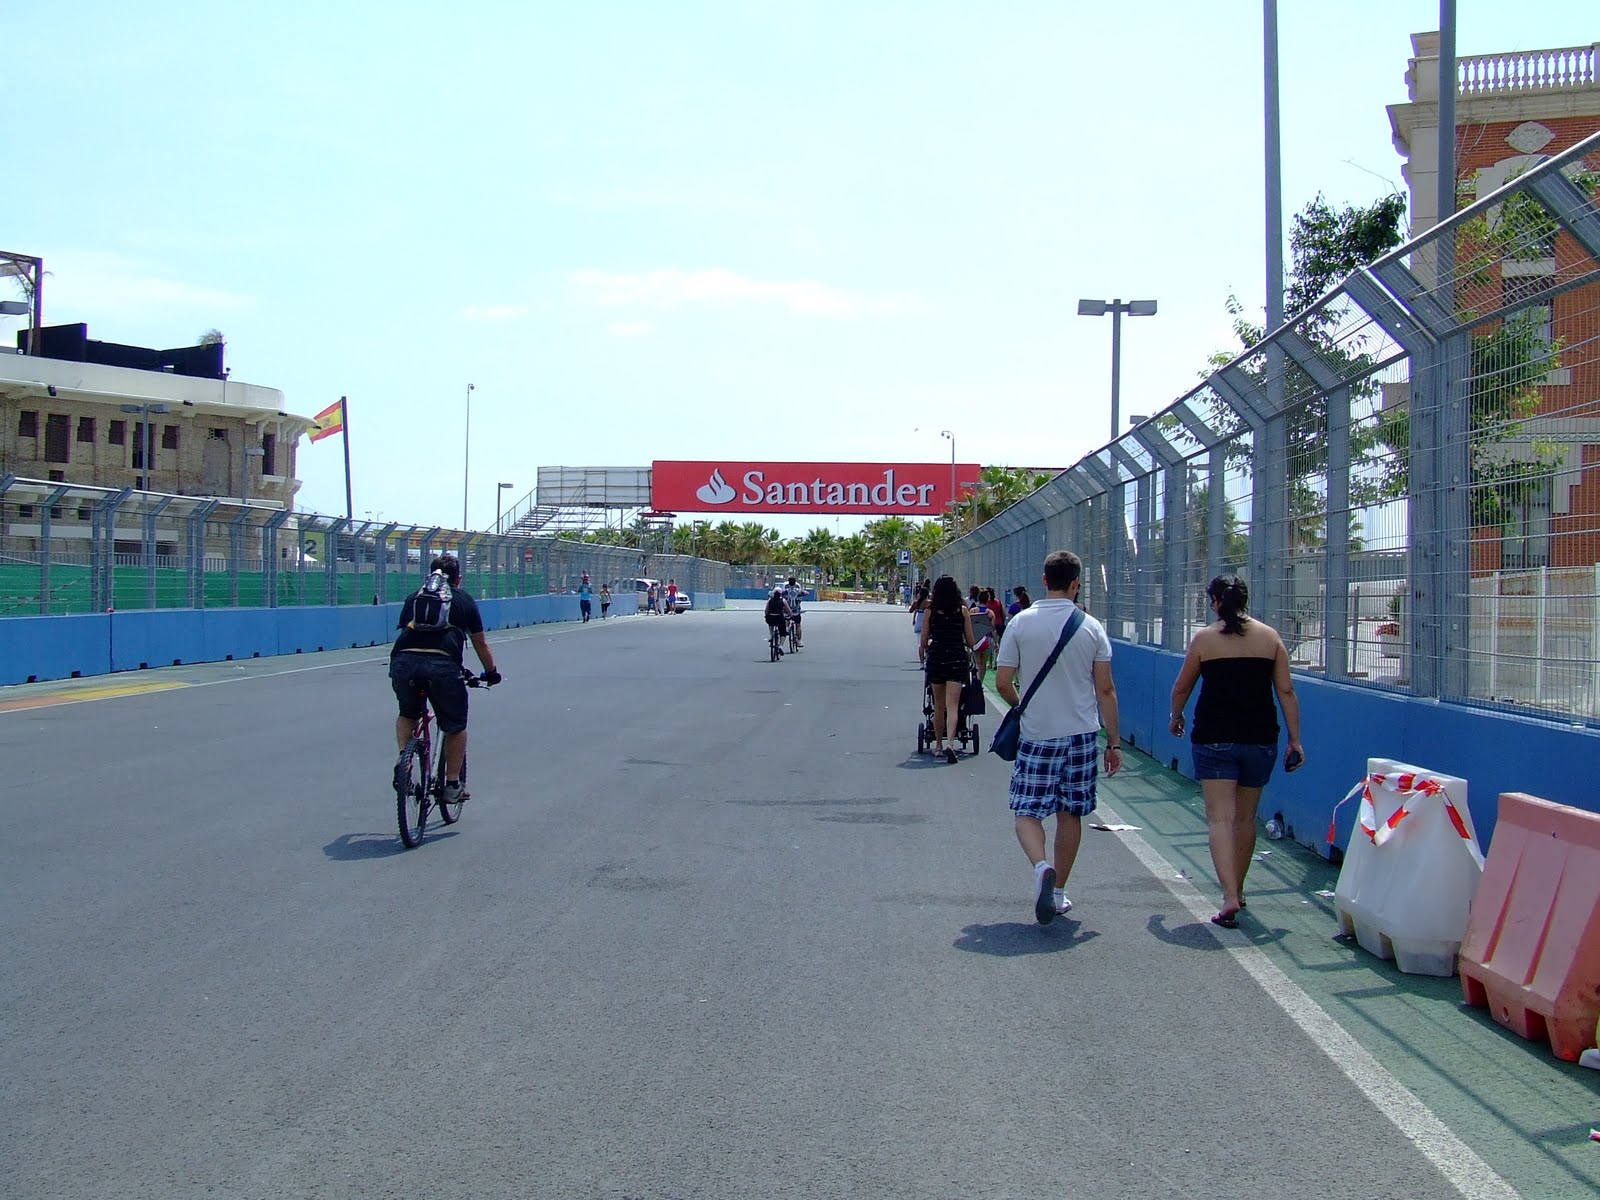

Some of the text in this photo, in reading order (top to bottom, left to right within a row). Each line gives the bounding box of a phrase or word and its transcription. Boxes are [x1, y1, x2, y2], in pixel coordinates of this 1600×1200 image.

[742, 469, 935, 506] Santander
[304, 539, 317, 555] 2
[901, 551, 908, 560] P
